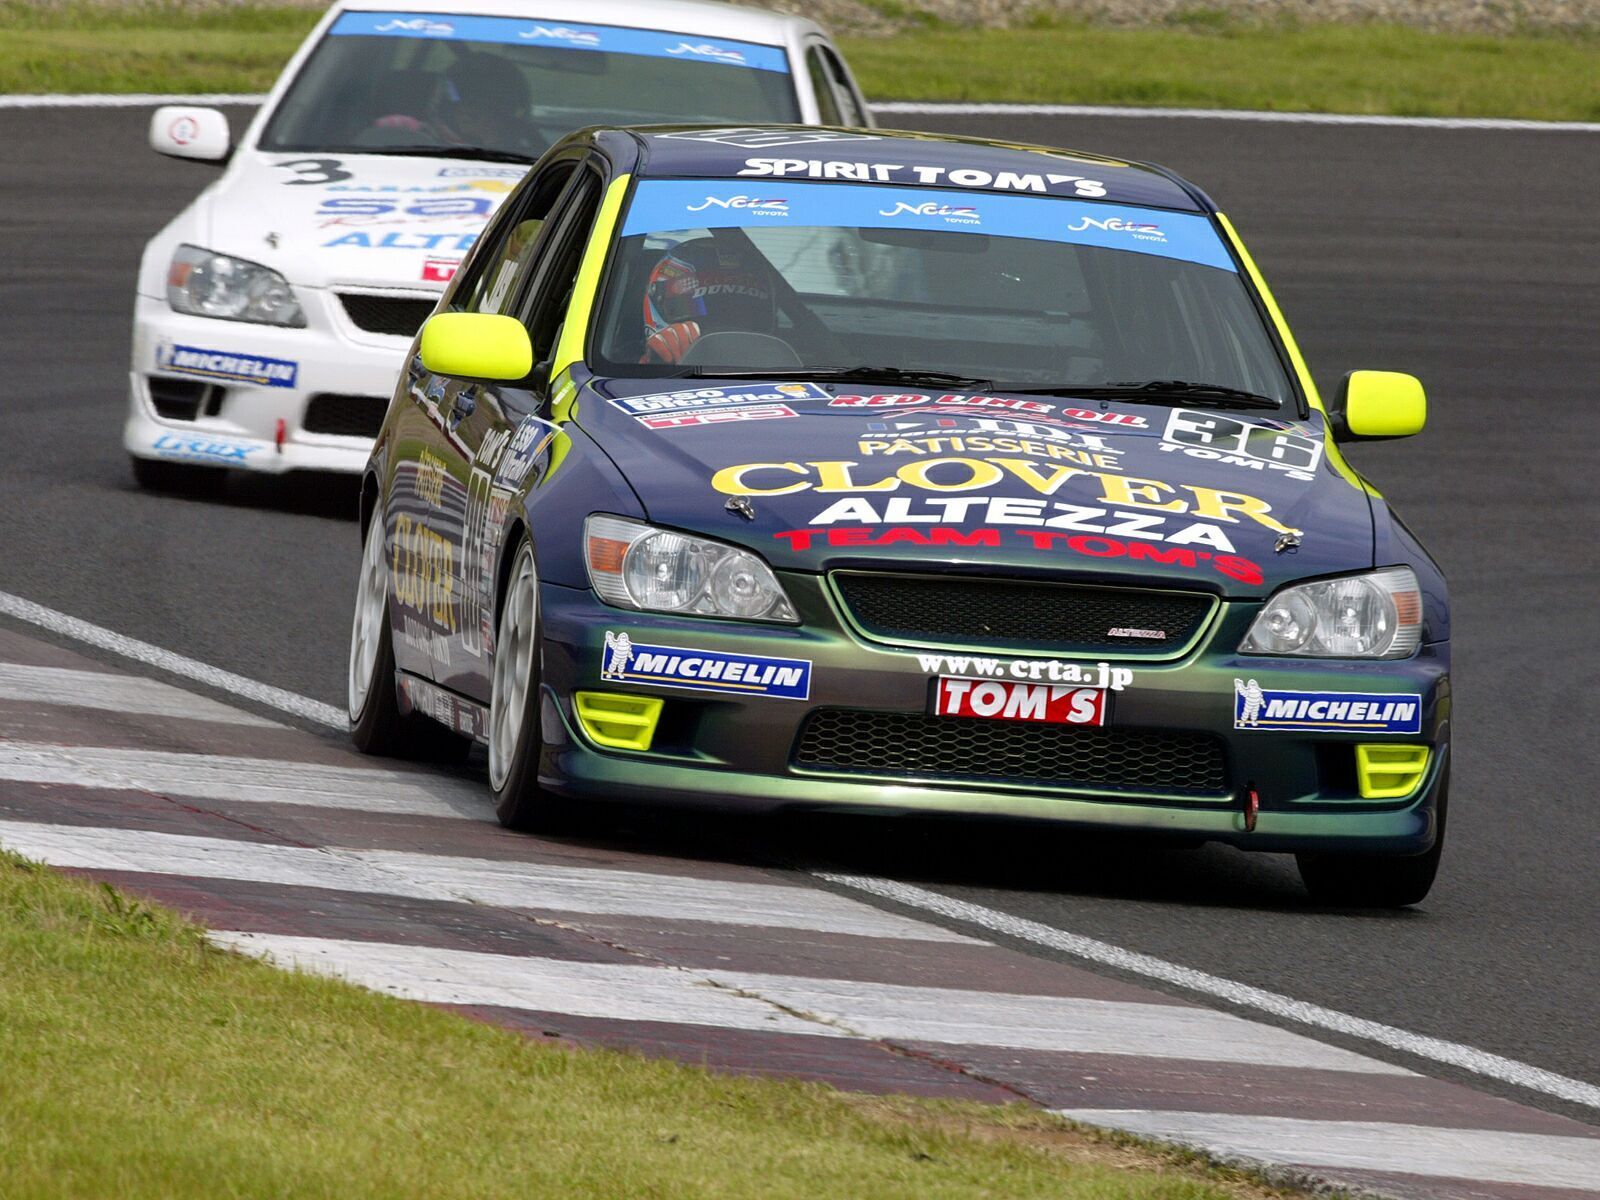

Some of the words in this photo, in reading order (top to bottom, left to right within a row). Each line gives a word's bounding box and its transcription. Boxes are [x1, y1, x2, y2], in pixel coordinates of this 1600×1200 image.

[274, 159, 354, 185] 3
[736, 157, 909, 182] SPIRIT
[912, 166, 1107, 198] TOM'S
[944, 217, 981, 225] TOYOTA
[1131, 233, 1168, 243] TOYOTA
[174, 350, 295, 381] MICHELIN
[827, 394, 931, 407] RED
[935, 395, 1056, 413] LINE
[1061, 407, 1150, 429] OIL
[1162, 408, 1324, 472] 36
[1157, 442, 1316, 481] TOM'S
[710, 457, 1304, 537] CLOVER
[808, 496, 1238, 553] ALTEZZA
[773, 528, 1000, 551] TEAM
[1014, 530, 1267, 586] TOM'S
[633, 652, 804, 687] MICHELIN
[915, 654, 1134, 691] www.crta.jp
[945, 680, 1099, 724] TOM'S
[1264, 699, 1416, 722] MICHELIN
